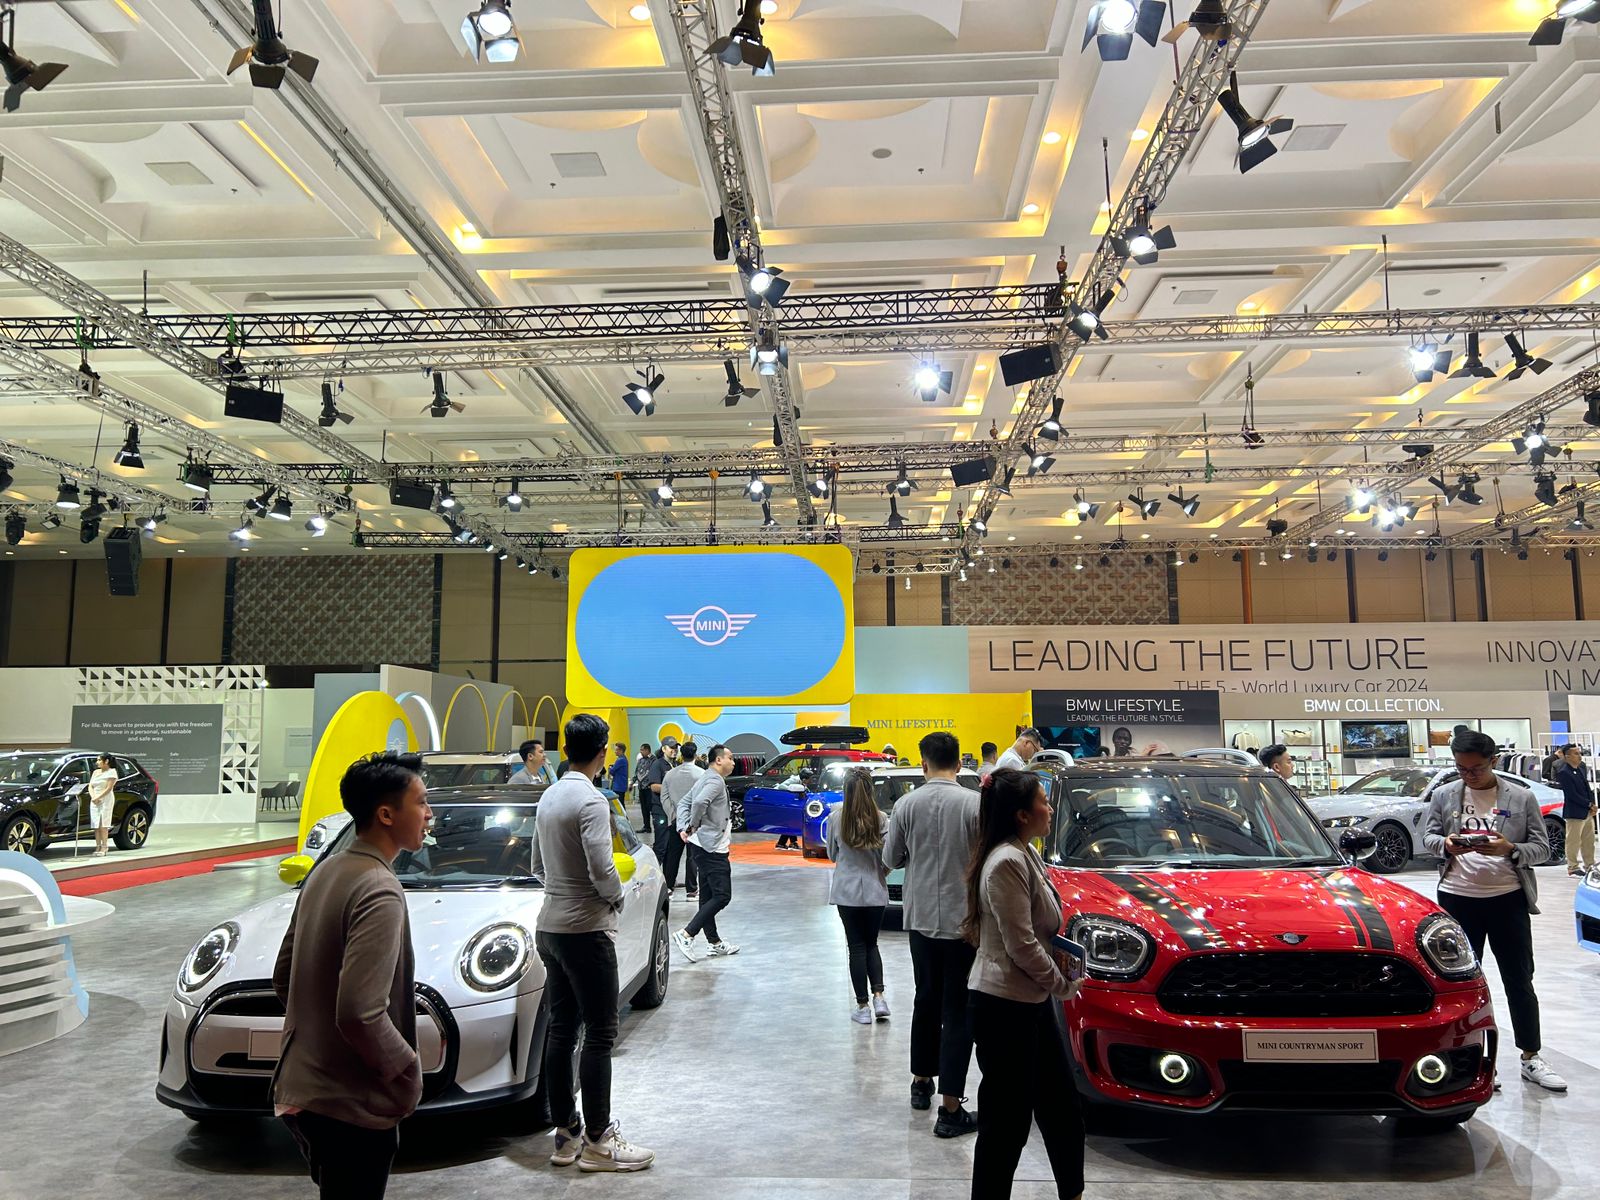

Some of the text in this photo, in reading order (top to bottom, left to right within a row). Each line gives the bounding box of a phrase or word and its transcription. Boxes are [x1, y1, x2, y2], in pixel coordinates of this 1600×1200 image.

[696, 620, 726, 631] MINI
[988, 637, 1428, 672] LEADING THE FUTURE
[1487, 640, 1600, 662] INNOVA
[1216, 680, 1226, 693] 5
[1241, 680, 1288, 693] World
[1354, 678, 1382, 692] Car
[1386, 678, 1428, 692] 2024
[1545, 669, 1572, 691] IN
[1066, 699, 1185, 712] BMW LIFESTYLE.
[1304, 698, 1444, 712] BMW COLLECTION.
[867, 719, 957, 728] MINI LIFESTYLE.
[1066, 714, 1185, 722] LEADING THE FUTURE IN STYLE.
[1257, 1042, 1364, 1050] MINI COUNTRYMAN SPORT
